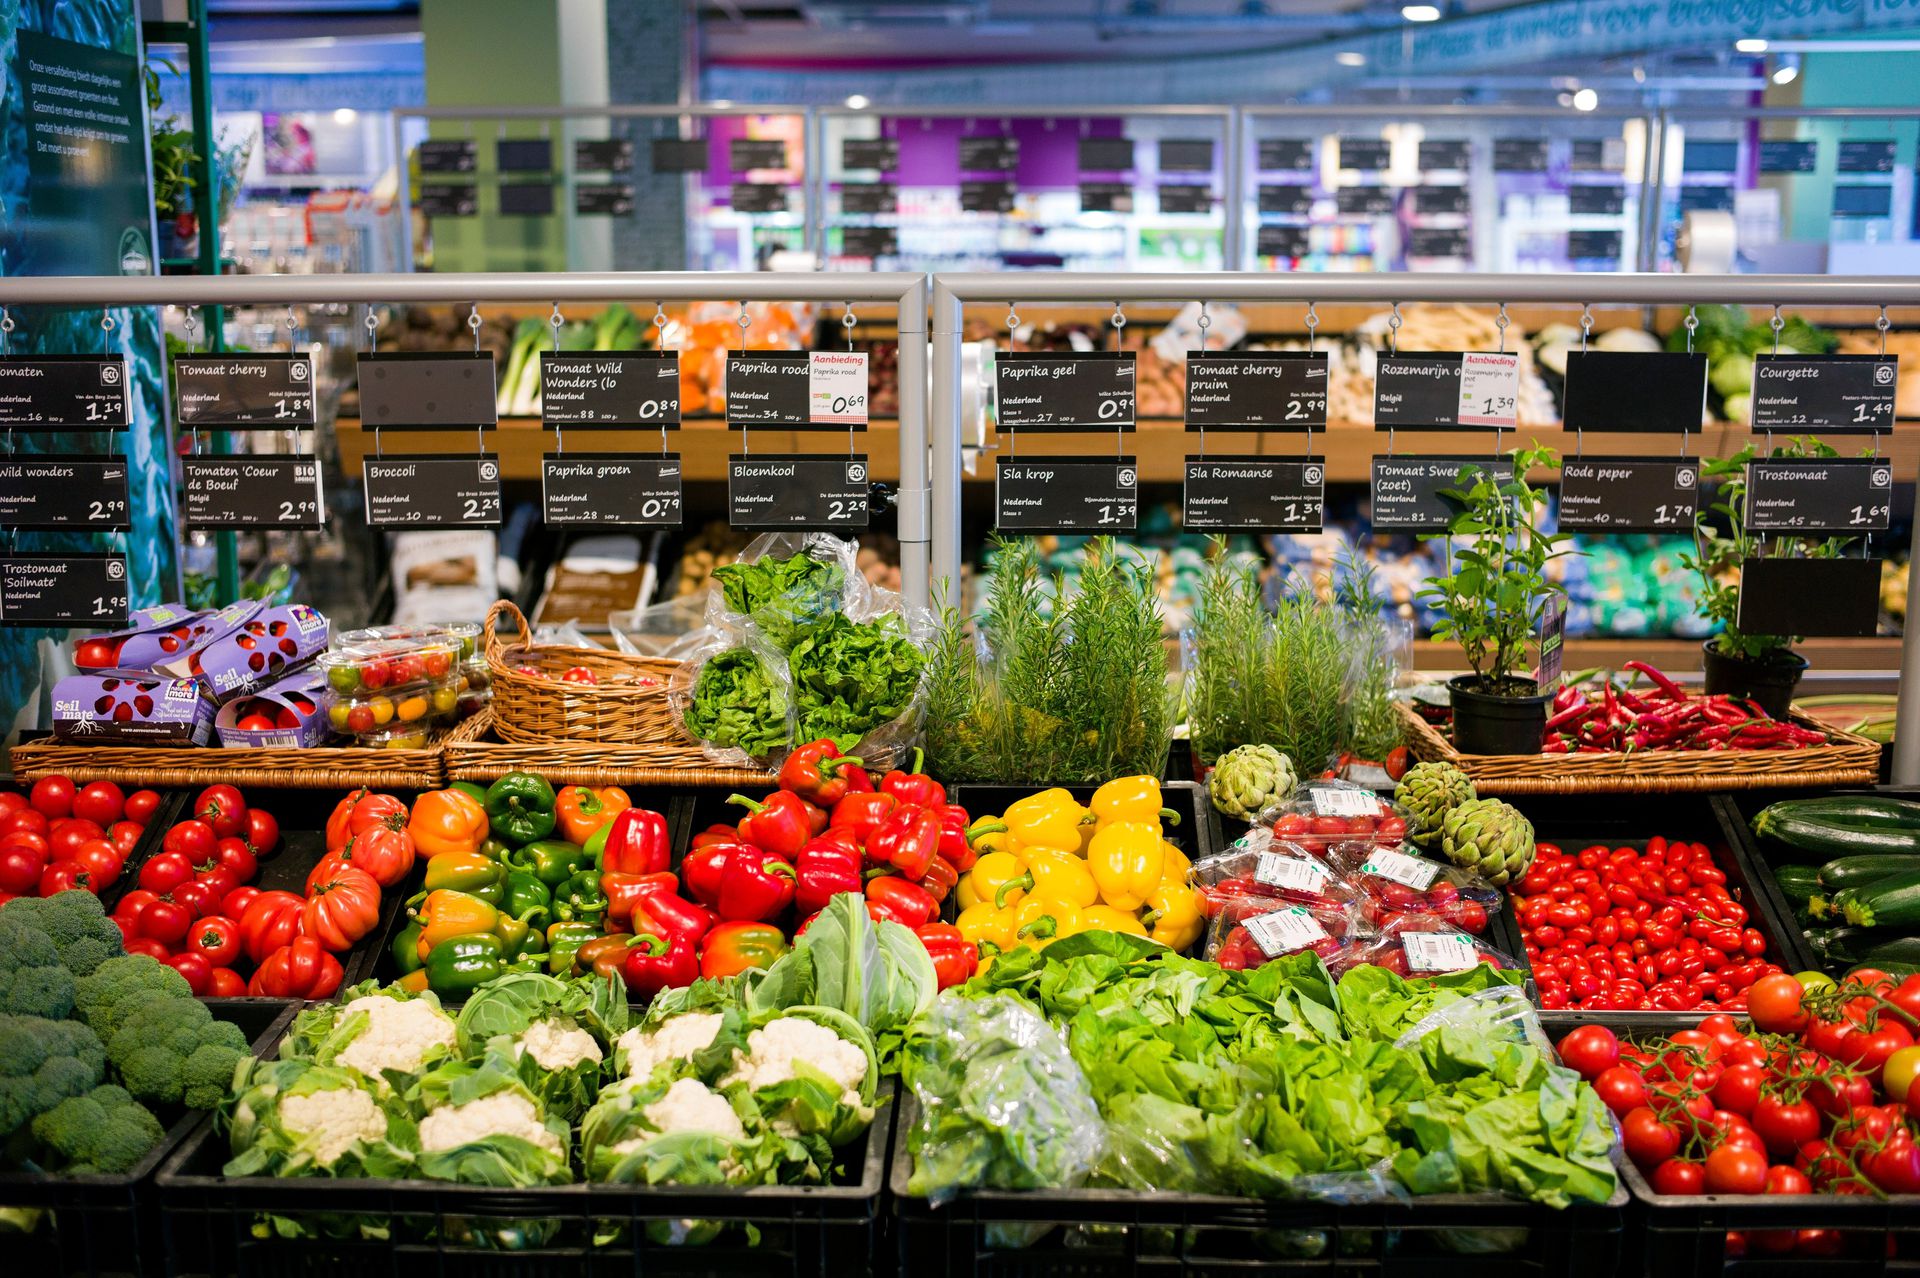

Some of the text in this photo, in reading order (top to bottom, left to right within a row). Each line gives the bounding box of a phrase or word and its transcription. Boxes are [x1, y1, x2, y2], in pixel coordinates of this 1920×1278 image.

[30, 60, 44, 73] Onze
[45, 65, 76, 82] versafdeling
[77, 69, 90, 81] biedt
[32, 82, 47, 94] groot
[48, 85, 78, 97] assortiment
[34, 101, 54, 114] Gezond
[55, 106, 62, 114] en
[63, 107, 73, 116] met
[74, 110, 84, 118] een
[84, 110, 96, 120] volle
[36, 122, 53, 133] omdat
[54, 124, 63, 135] het
[37, 141, 47, 152] Dat
[48, 144, 63, 154] moet
[813, 355, 863, 366] Aanbieding
[1466, 355, 1516, 368] Aanbieding
[180, 363, 267, 378] Tomaat cherry
[545, 362, 622, 374] Tomaat Wild
[731, 361, 809, 376] Paprika rood
[813, 368, 839, 377] Paprika
[1002, 363, 1076, 381] Paprika geel
[1191, 364, 1282, 378] Tomaat cherry
[1381, 364, 1450, 379] Rozemarijn
[1465, 368, 1513, 379] Rozemarijn op
[1760, 366, 1819, 381] Courgette
[545, 376, 617, 390] Wonders (lo
[1191, 378, 1228, 393] pruim
[183, 394, 220, 402] Nederland
[546, 392, 585, 400] Nederland
[730, 391, 769, 400] Nederland
[1002, 396, 1042, 405] Nederland
[1191, 394, 1230, 402] Nederland
[1380, 394, 1402, 403] België
[1758, 396, 1798, 405] Nederland
[275, 399, 311, 418] 1.89
[639, 400, 678, 418] 0.89
[832, 395, 865, 414] 0.69
[1285, 400, 1325, 420] 2.99
[1482, 397, 1515, 415] 1.39
[28, 413, 42, 421] 16
[86, 402, 122, 421] 1.19
[580, 410, 594, 419] 88
[763, 410, 778, 419] 34
[1037, 413, 1053, 422] 27
[1852, 403, 1893, 423] 1.49
[1791, 414, 1807, 424] 12
[0, 466, 74, 477] Wild wonders
[187, 466, 279, 477] Tomaten 'Coeur
[295, 466, 315, 476] BIO
[371, 464, 416, 478] Broccoli
[548, 464, 631, 479] Paprika groen
[734, 465, 795, 477] Bloemkool
[1003, 468, 1054, 483] Sla krop
[1190, 467, 1273, 478] Sla Romaanse
[1377, 465, 1425, 476] Tomaat
[1429, 466, 1459, 477] Swee
[1564, 465, 1632, 482] Rode peper
[1758, 470, 1828, 480] Trostomaat
[188, 478, 240, 490] de Boeuf
[1377, 479, 1411, 492] (zoet)
[0, 495, 36, 503] Nederland
[189, 494, 210, 503] België
[372, 494, 410, 503] Nederland
[549, 494, 587, 502] Nederland
[735, 495, 773, 503] Nederland
[1003, 498, 1042, 506] Nederland
[1189, 497, 1228, 505] Nederland
[1377, 495, 1416, 503] Nederland
[1562, 496, 1601, 504] Nederland
[1756, 499, 1795, 507] Nederland
[89, 501, 125, 520] 2.99
[279, 501, 316, 520] 2.99
[463, 498, 499, 519] 2.29
[641, 499, 680, 518] 0.79
[828, 500, 867, 520] 2.29
[1098, 505, 1136, 524] 1.39
[1284, 503, 1322, 522] 1.39
[1653, 504, 1692, 524] 1.79
[1849, 505, 1888, 524] 1.69
[222, 511, 236, 520] 71
[406, 512, 421, 520] 10
[583, 511, 597, 520] 28
[1411, 513, 1426, 522] 81
[1593, 513, 1609, 523] 40
[1788, 516, 1805, 526] 45
[3, 563, 67, 574] Trostomaat
[4, 576, 57, 588] 'Soilmate'
[92, 597, 127, 615] 1.95
[214, 667, 238, 686] Soil
[224, 671, 254, 691] mate
[168, 690, 193, 699] more
[55, 700, 79, 711] Soil
[62, 710, 94, 720] mate
